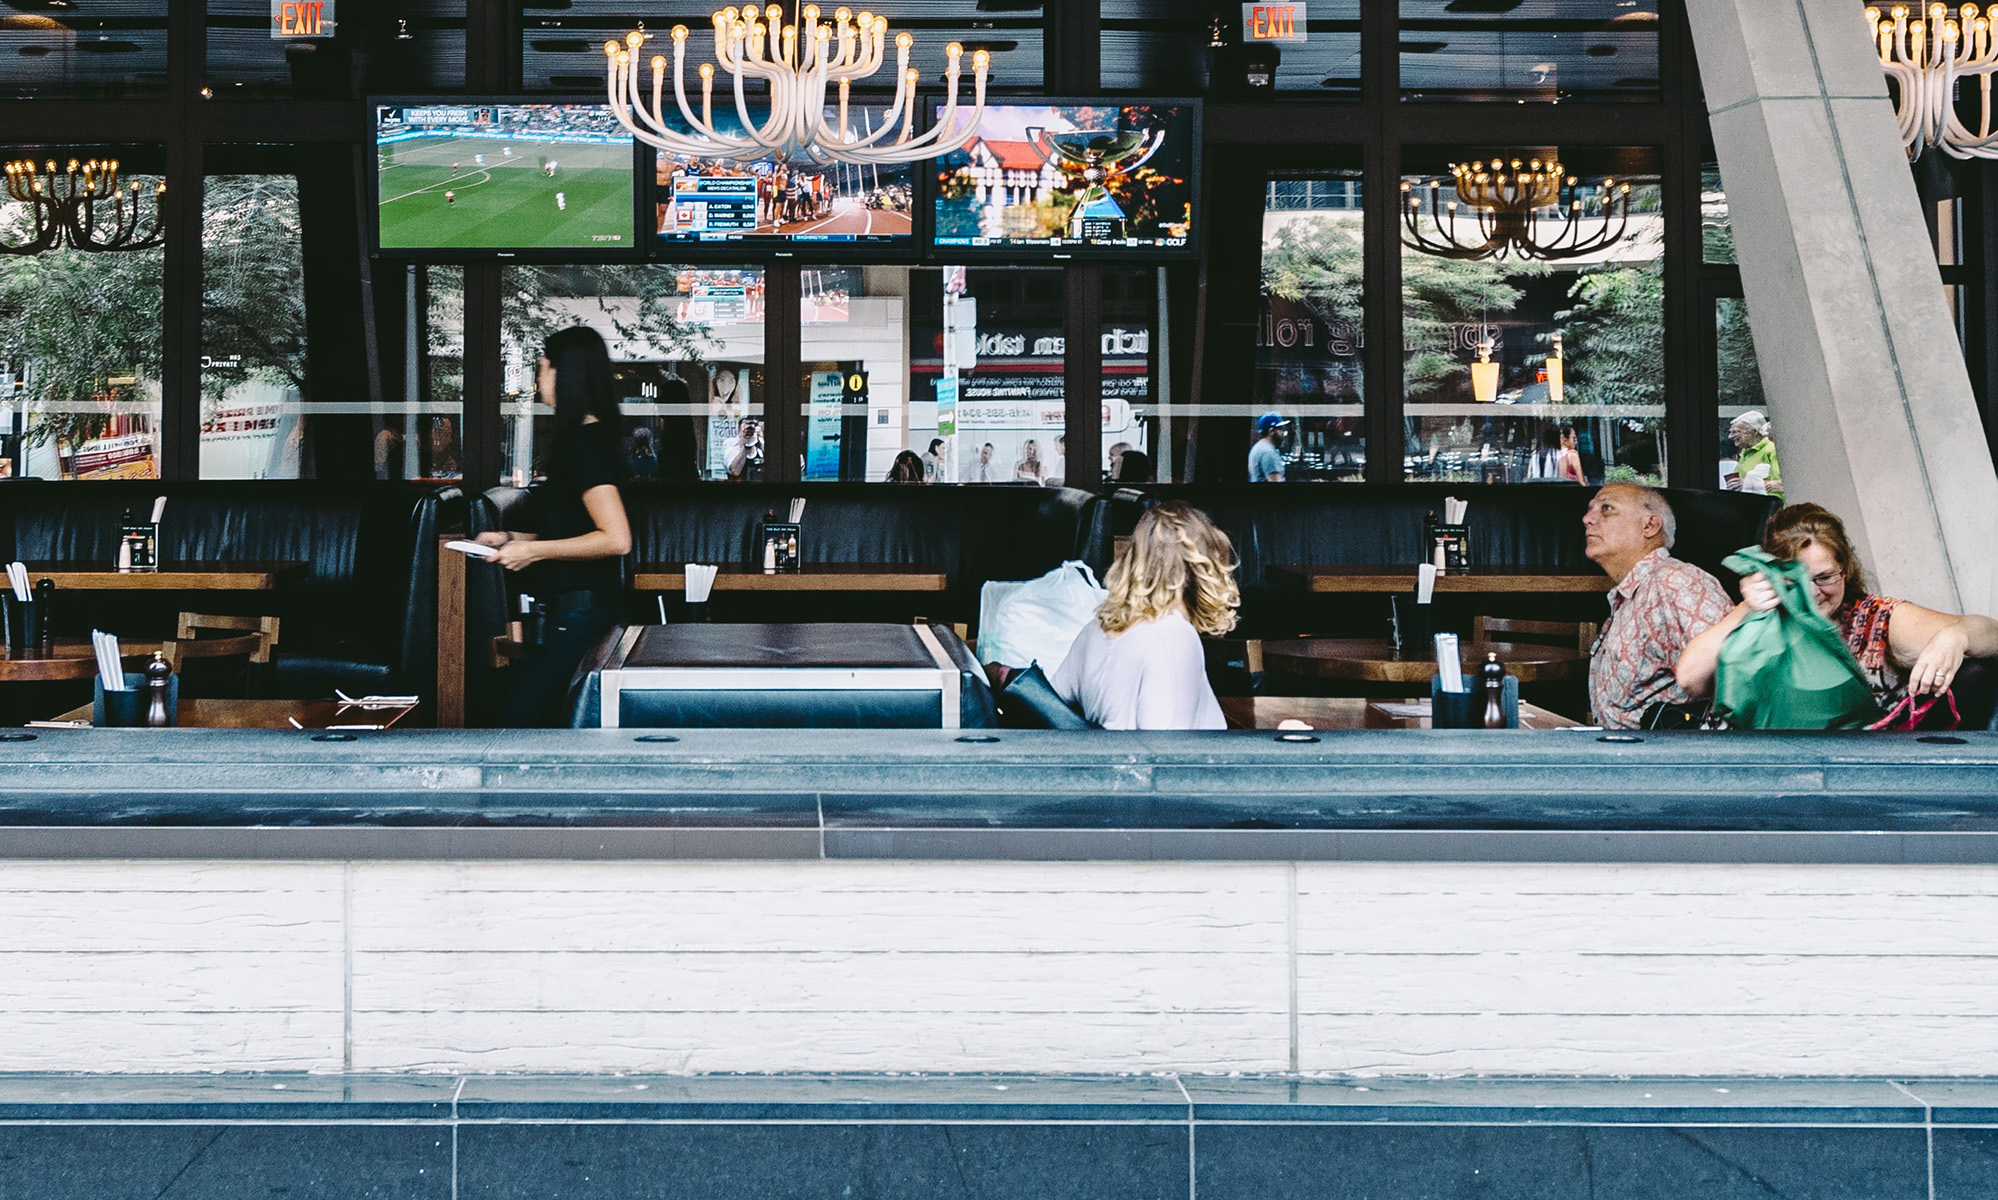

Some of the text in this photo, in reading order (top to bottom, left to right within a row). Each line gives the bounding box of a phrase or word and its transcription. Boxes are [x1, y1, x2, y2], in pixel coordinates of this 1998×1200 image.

[281, 2, 324, 36] EXIT
[1253, 6, 1296, 39] EXIT
[411, 109, 468, 117] KEEPS YOU FRESH
